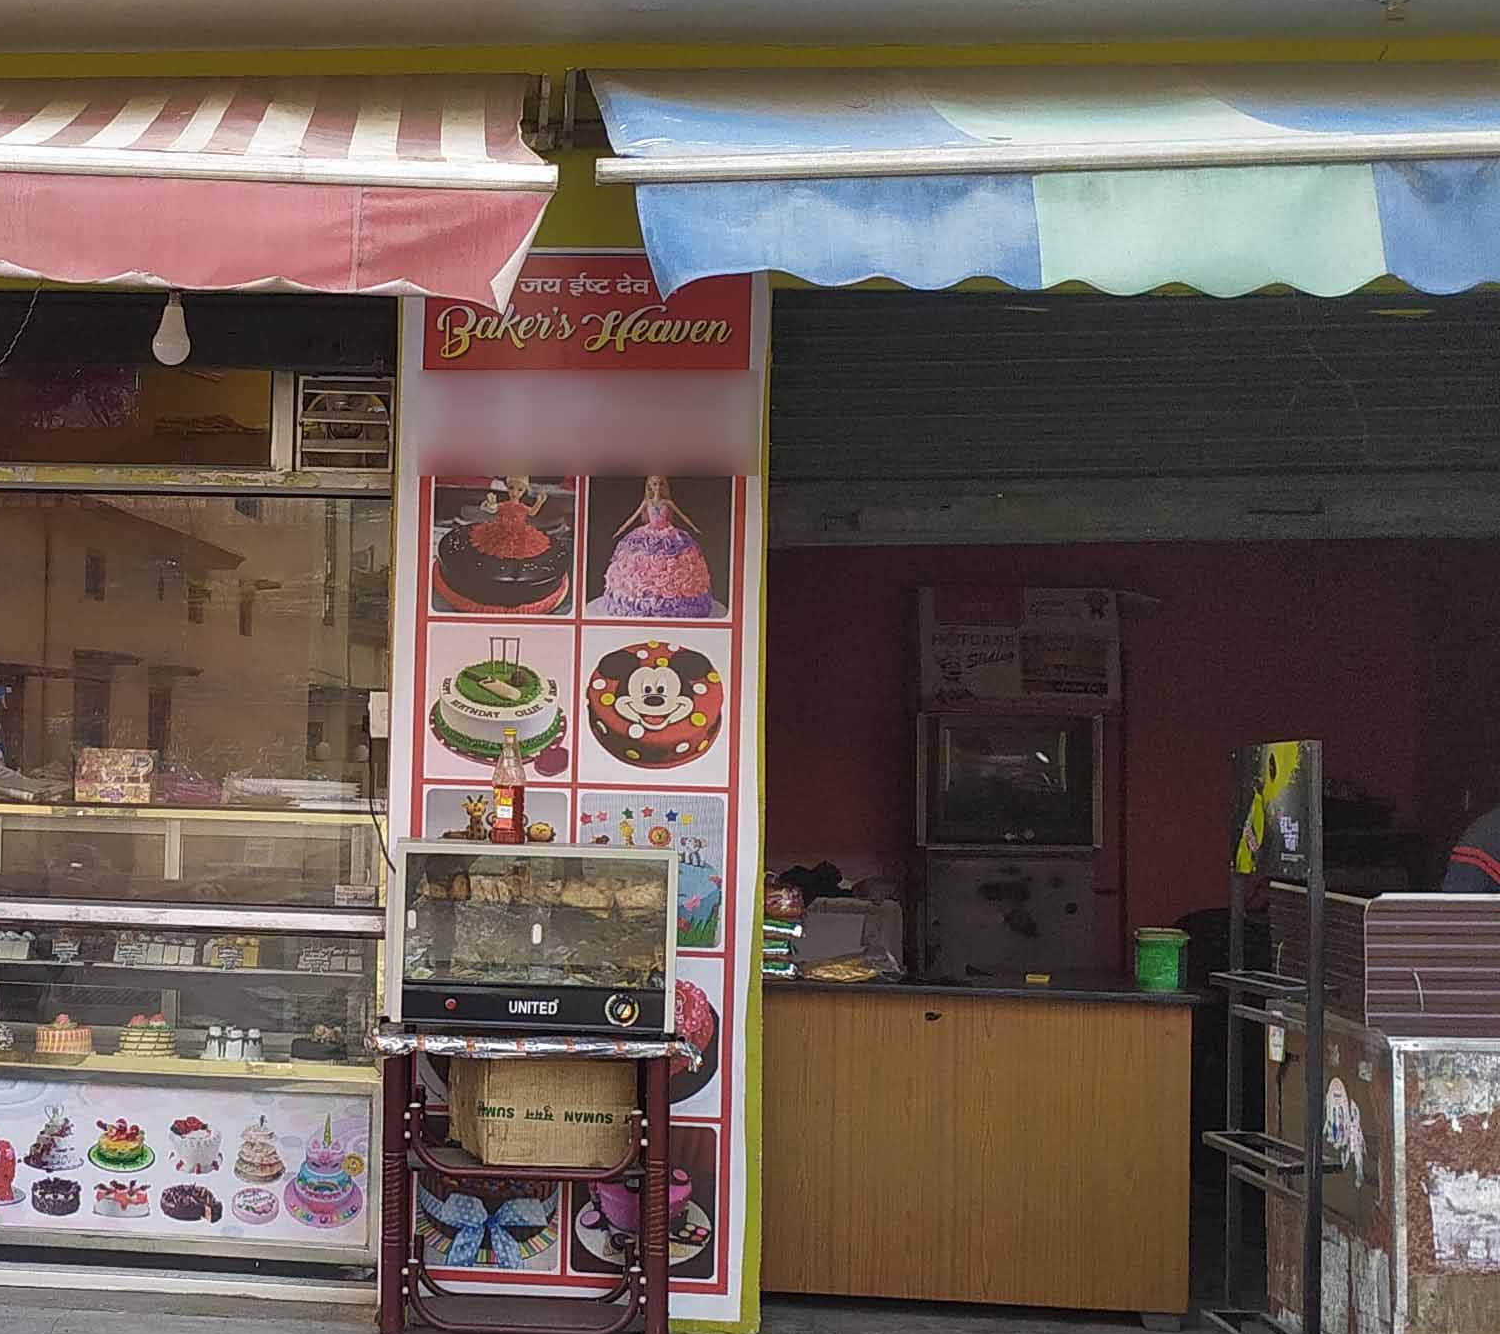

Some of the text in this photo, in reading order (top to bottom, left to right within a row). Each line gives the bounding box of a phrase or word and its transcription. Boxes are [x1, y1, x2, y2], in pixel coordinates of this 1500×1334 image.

[518, 277, 563, 294] जय
[615, 273, 651, 294] देव
[436, 305, 732, 359] Baker's Heaven
[508, 1000, 558, 1015] UNITED
[563, 1110, 614, 1124] SUMAN
